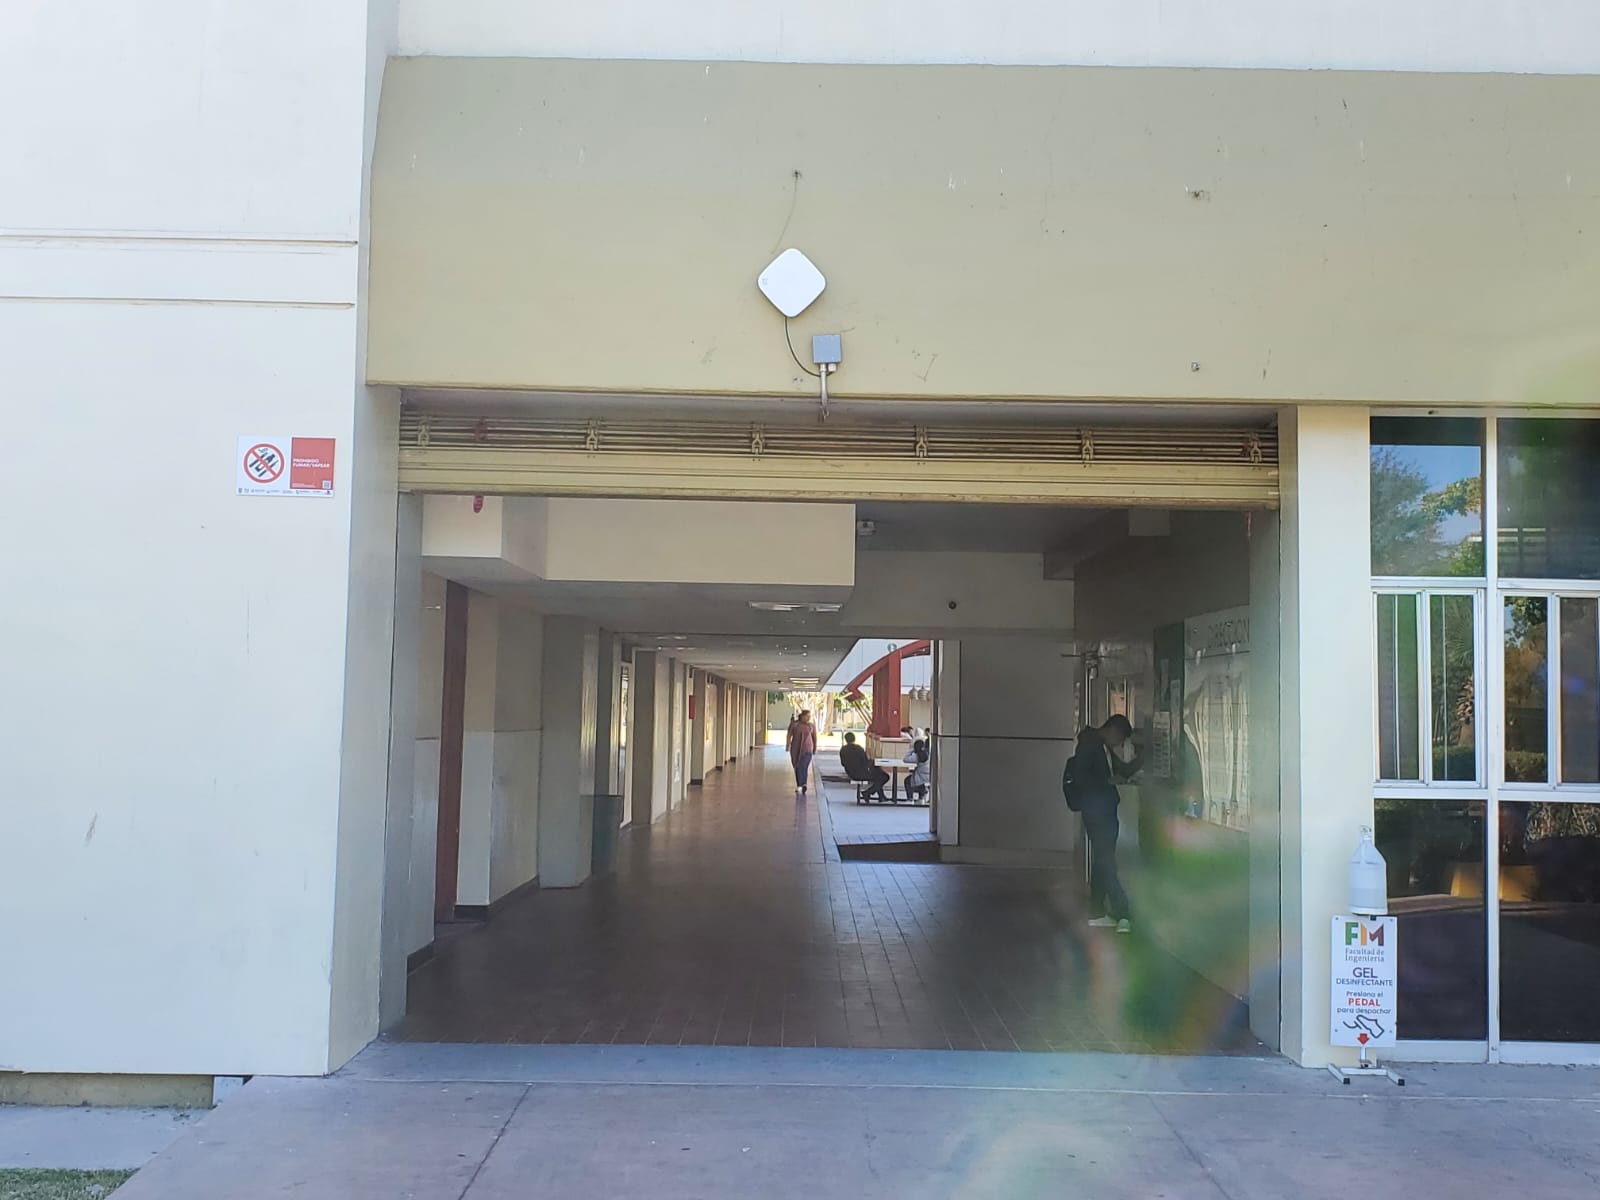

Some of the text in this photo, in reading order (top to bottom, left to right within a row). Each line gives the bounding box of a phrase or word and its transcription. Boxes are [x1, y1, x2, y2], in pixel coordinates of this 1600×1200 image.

[1352, 967, 1378, 978] GEL
[1336, 978, 1392, 986] DESINFECTANTE
[1348, 998, 1381, 1006] PEDAL
